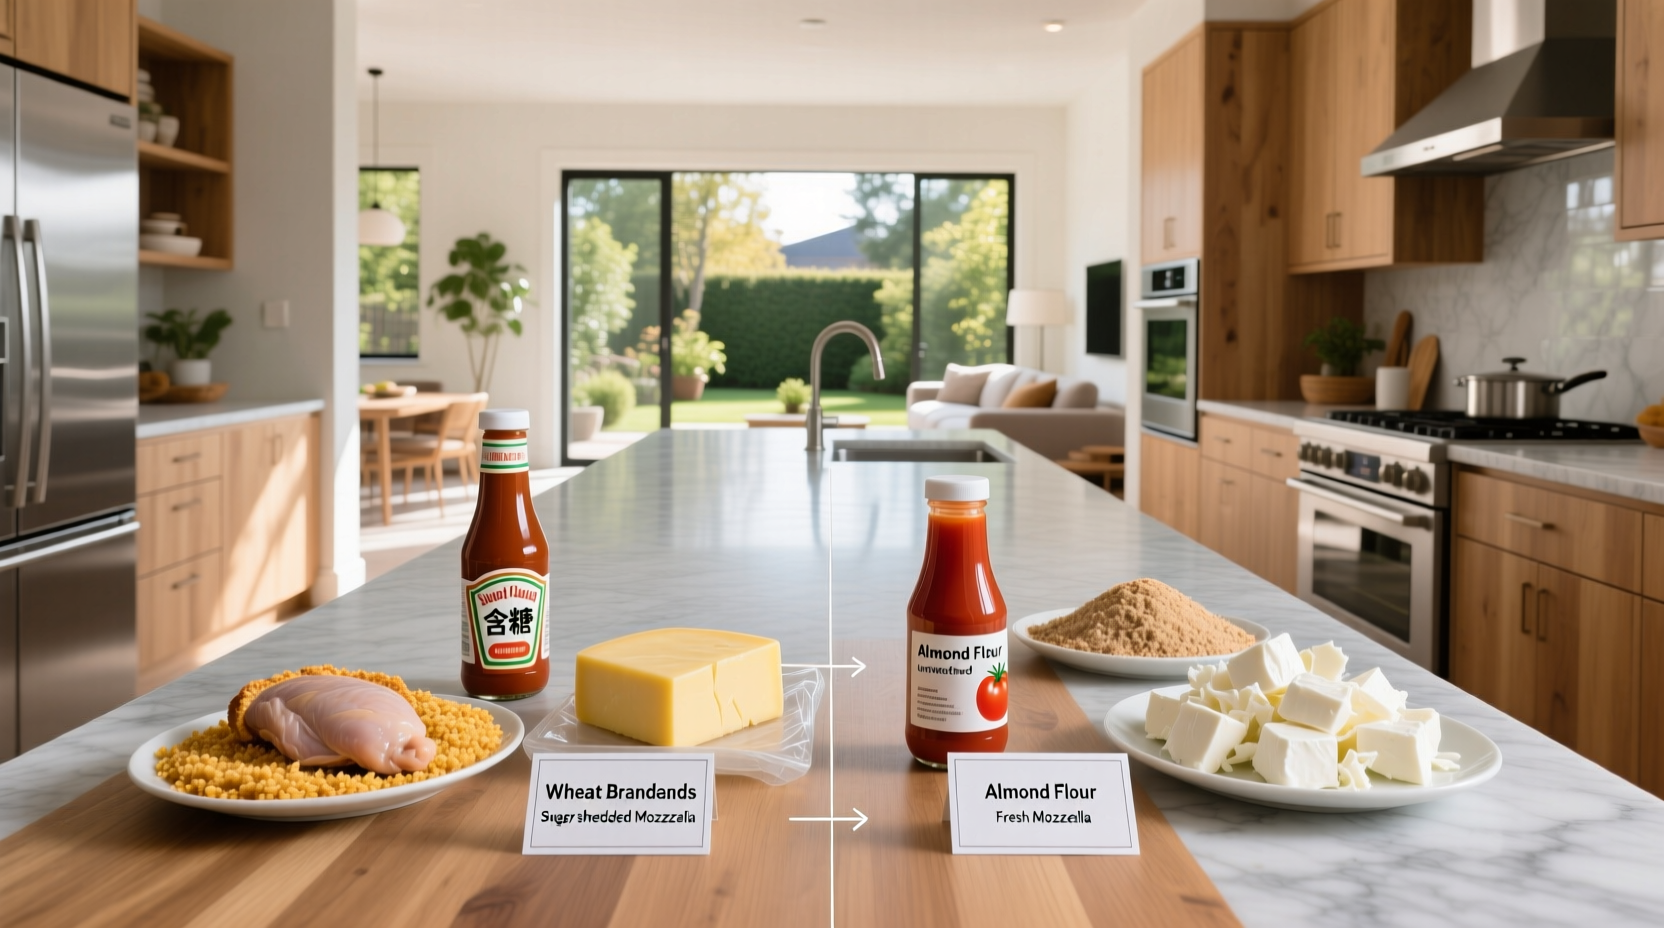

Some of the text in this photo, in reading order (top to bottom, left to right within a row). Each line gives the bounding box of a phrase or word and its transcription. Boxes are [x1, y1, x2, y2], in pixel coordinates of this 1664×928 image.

[483, 607, 534, 636] 含糖
[918, 644, 970, 660] Almond
[546, 783, 602, 800] Wheat
[985, 783, 1097, 799] Almond Flour
[996, 810, 1029, 823] Fresh
